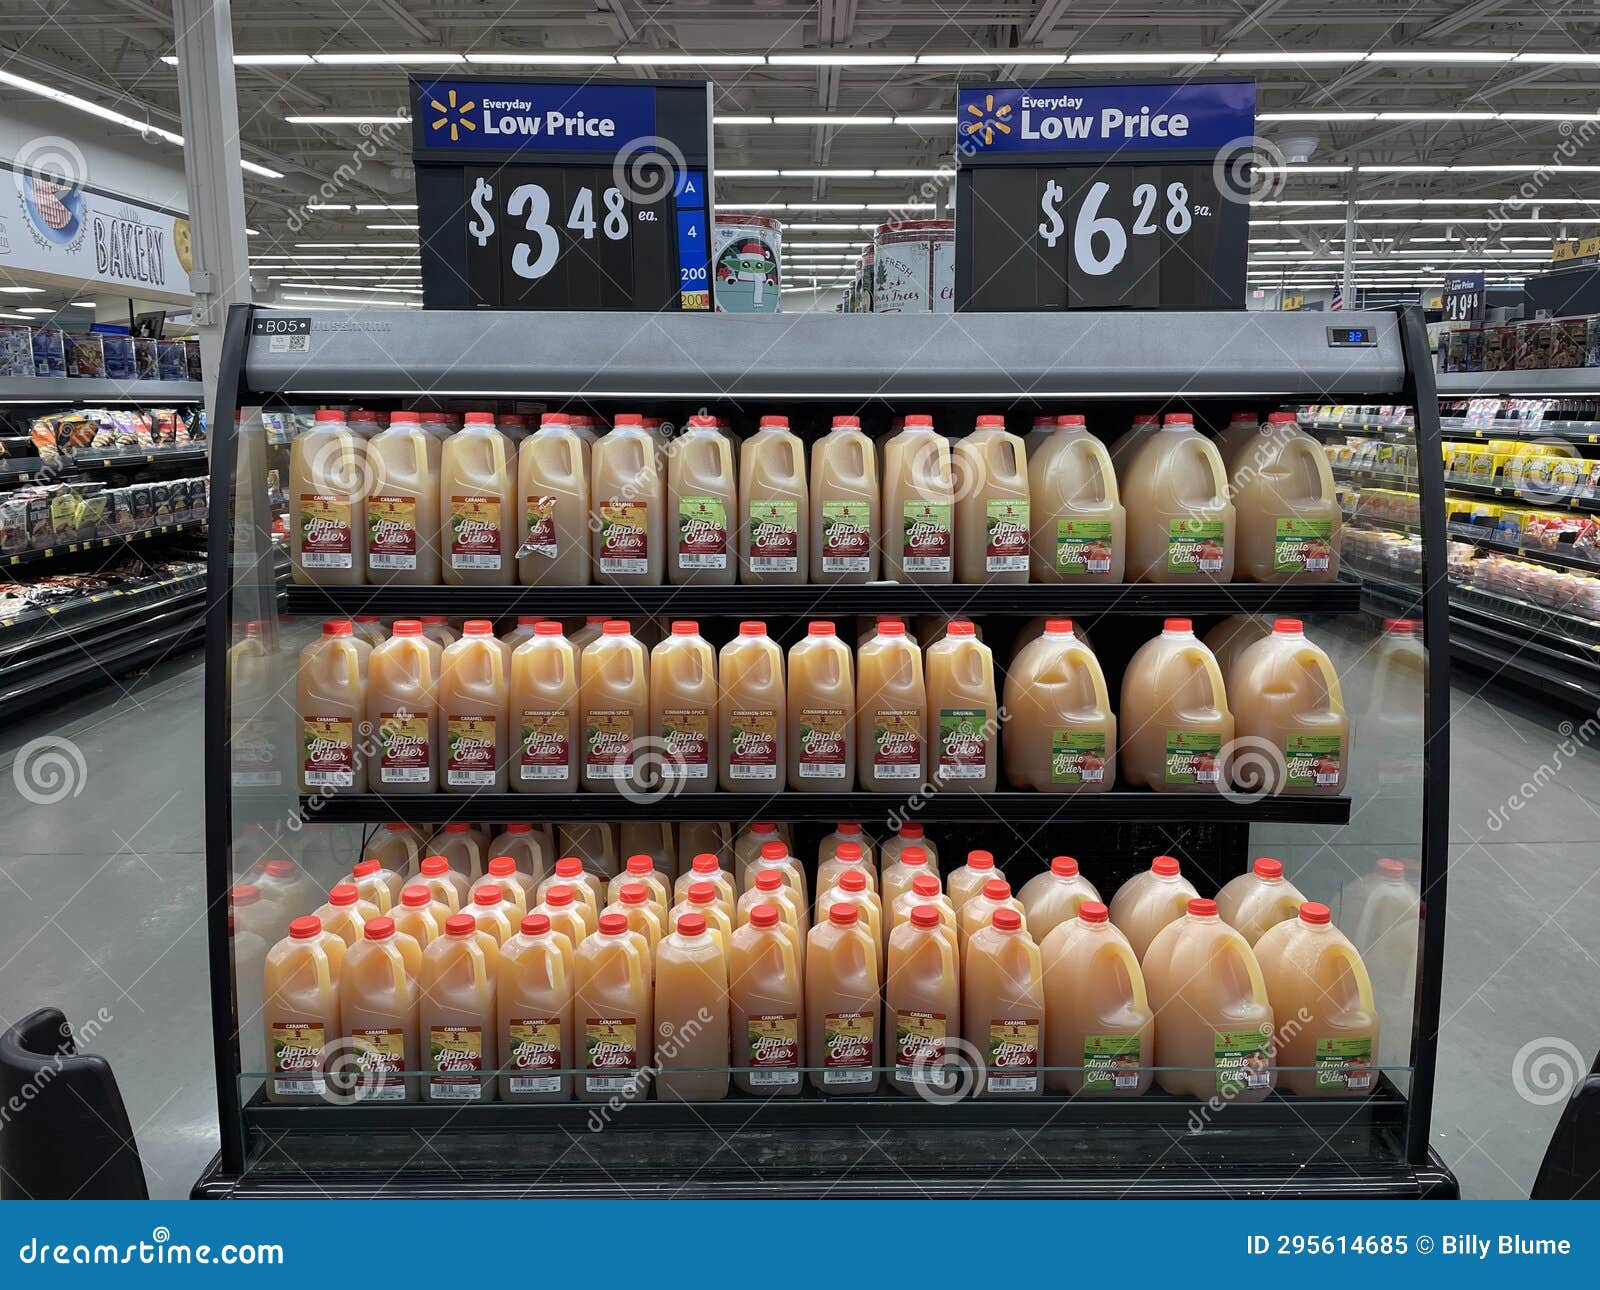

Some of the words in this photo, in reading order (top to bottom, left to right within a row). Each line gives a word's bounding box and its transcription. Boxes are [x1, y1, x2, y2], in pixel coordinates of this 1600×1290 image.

[483, 99, 532, 112] Everyday
[1021, 96, 1083, 110] Everyday
[483, 110, 541, 135] Low
[547, 111, 615, 137] Price
[1021, 110, 1094, 139] Low
[1101, 106, 1189, 138] Price
[685, 180, 696, 193] A
[687, 225, 697, 238] 4
[94, 217, 165, 286] BAKERY
[681, 268, 707, 280] 200
[885, 257, 913, 278] FRESH
[1451, 283, 1462, 291] Low
[1462, 281, 1475, 289] Price
[892, 290, 920, 302] Trees
[304, 517, 347, 531] Apple
[372, 520, 414, 532] Apple
[455, 520, 497, 533] Apple
[603, 523, 644, 537] Apple
[681, 520, 722, 533] Apple
[752, 523, 794, 535] Apple
[825, 523, 866, 535] Apple
[906, 522, 947, 535] Apple
[989, 522, 1027, 535] Apple
[307, 531, 347, 544] Cider
[373, 532, 411, 545] Cider
[458, 532, 496, 545] Cider
[605, 536, 643, 549] Cider
[684, 532, 721, 544] Cider
[755, 535, 793, 548] Cider
[828, 535, 865, 548] Cider
[909, 535, 946, 548] Cider
[992, 535, 1027, 547] Cider
[1057, 543, 1089, 556] Apple
[1169, 542, 1202, 554] Apple
[1275, 541, 1309, 554] Apple
[1059, 554, 1088, 565] Cider
[1171, 553, 1201, 565] Cider
[1278, 552, 1309, 564] Cider
[383, 734, 425, 747] Apple
[523, 730, 566, 745] Apple
[589, 730, 631, 744] Apple
[664, 729, 705, 744] Apple
[732, 731, 772, 744] Apple
[802, 730, 842, 742] Apple
[877, 731, 916, 744] Apple
[942, 732, 983, 744] Apple
[307, 737, 348, 751] Apple
[451, 737, 491, 750] Apple
[526, 744, 563, 756] Cider
[592, 743, 629, 756] Cider
[667, 742, 703, 755] Cider
[735, 744, 772, 756] Cider
[805, 742, 841, 754] Cider
[880, 743, 915, 756] Cider
[946, 743, 982, 756] Cider
[310, 750, 347, 762] Cider
[387, 746, 424, 759] Cider
[453, 749, 491, 761] Cider
[1053, 753, 1084, 765] Apple
[1168, 754, 1200, 765] Apple
[1287, 757, 1319, 769] Apple
[1055, 764, 1082, 775] Cider
[1169, 764, 1198, 776] Cider
[1289, 768, 1318, 779] Cider
[751, 1036, 794, 1049] Apple
[827, 1035, 869, 1048] Apple
[899, 1033, 941, 1048] Apple
[276, 1045, 321, 1059] Apple
[513, 1041, 558, 1056] Apple
[589, 1041, 633, 1055] Apple
[755, 1048, 793, 1061] Cider
[830, 1047, 868, 1059] Cider
[902, 1046, 941, 1059] Cider
[993, 1042, 1034, 1056] Apple
[434, 1048, 479, 1062] Apple
[516, 1055, 556, 1067] Cider
[592, 1054, 631, 1067] Cider
[995, 1054, 1033, 1067] Cider
[279, 1058, 320, 1071] Cider
[436, 1061, 478, 1072] Cider
